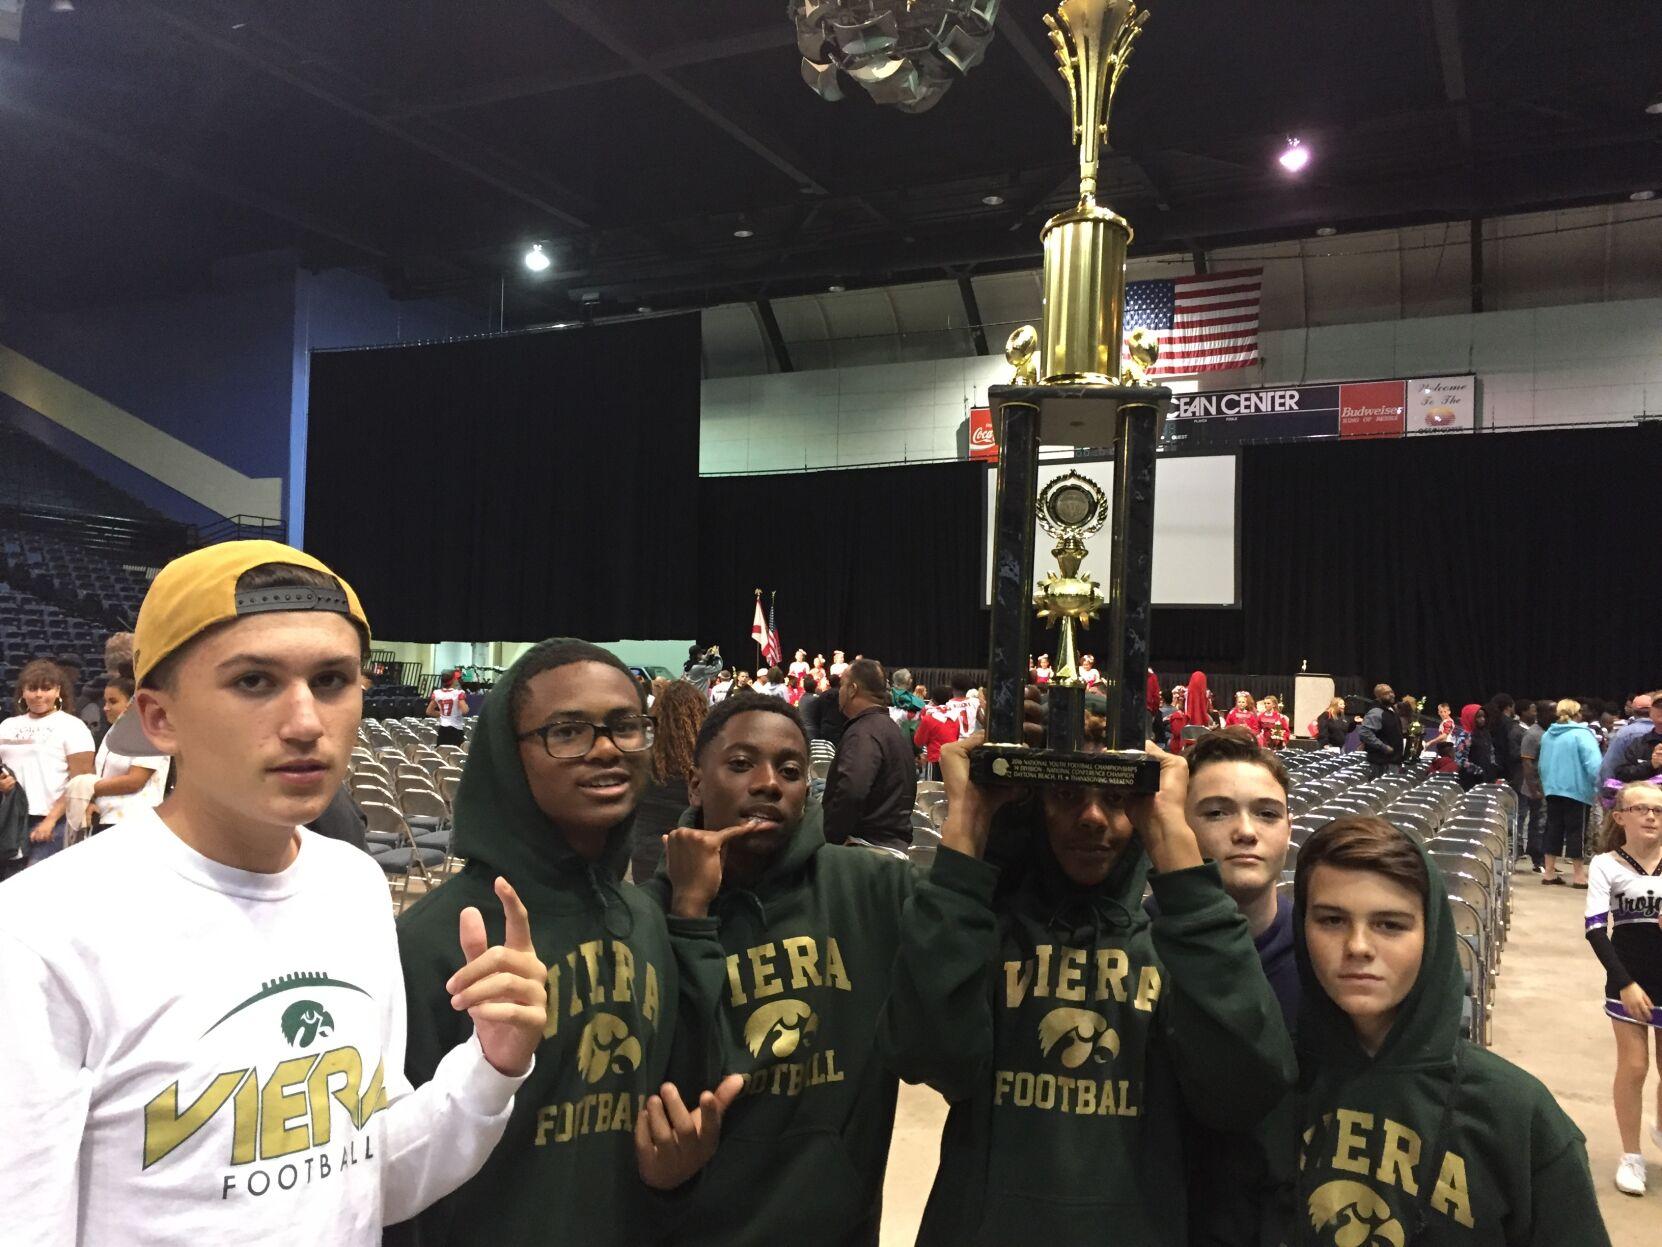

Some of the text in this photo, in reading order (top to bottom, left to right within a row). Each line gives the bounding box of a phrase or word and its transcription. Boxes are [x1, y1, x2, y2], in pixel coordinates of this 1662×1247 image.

[1166, 390, 1300, 419] CEAN CENTER
[1341, 405, 1404, 418] Budweiser
[1440, 395, 1462, 405] The
[725, 936, 852, 1008] IERA
[1003, 945, 1162, 1013] VIERA
[994, 1070, 1139, 1117] FOOTBAL
[221, 1135, 374, 1200] FOOTBALL
